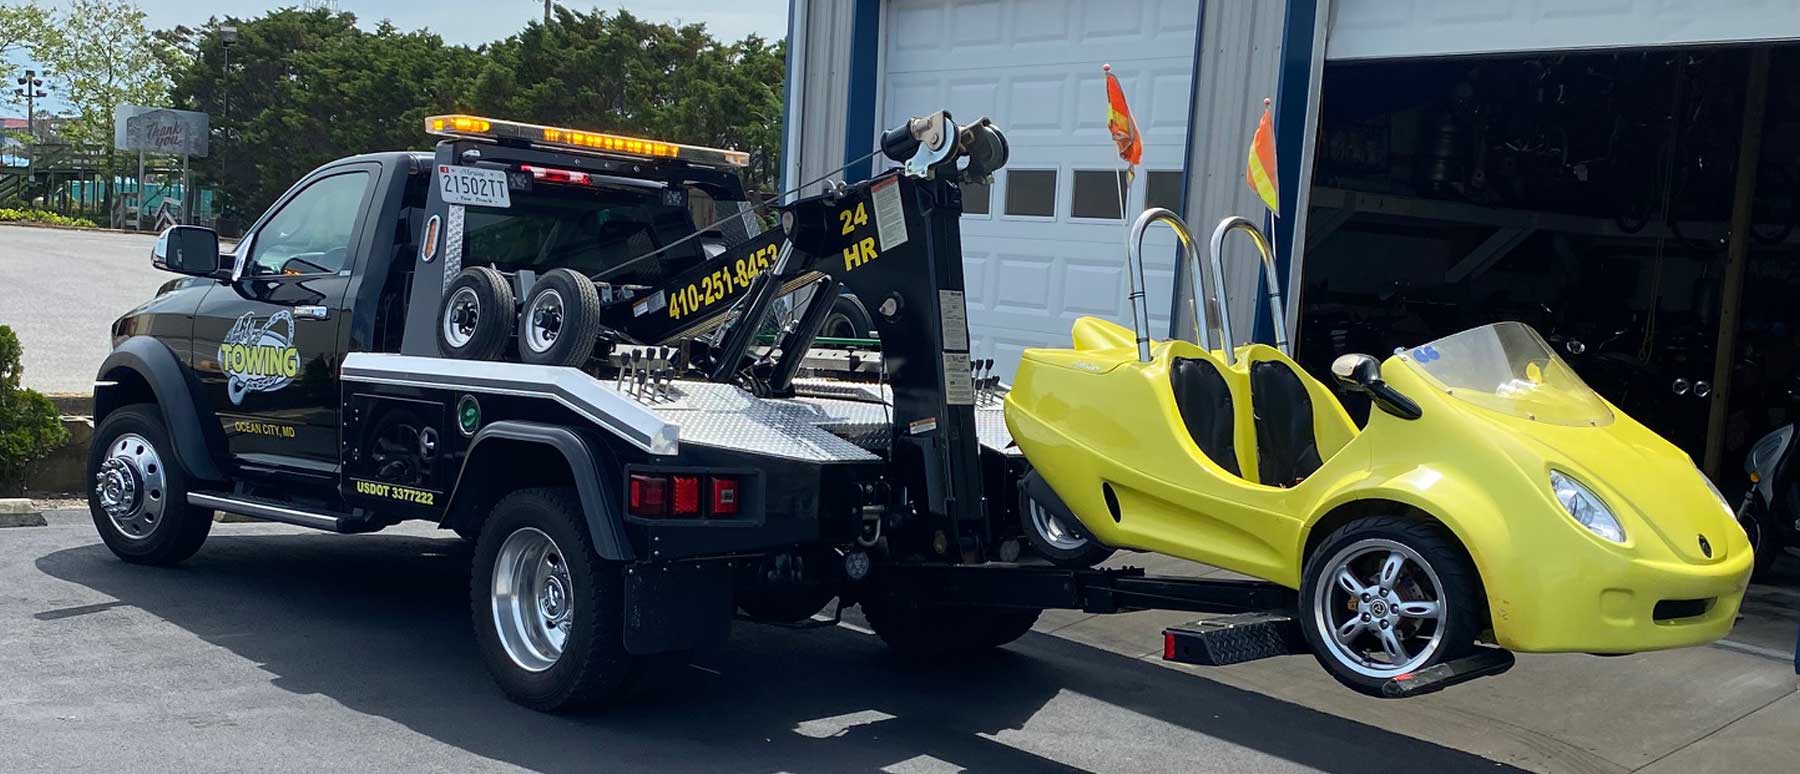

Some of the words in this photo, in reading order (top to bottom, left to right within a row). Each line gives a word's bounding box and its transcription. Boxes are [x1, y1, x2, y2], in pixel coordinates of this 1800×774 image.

[147, 120, 182, 139] Thank
[443, 174, 505, 198] 21502TT
[839, 201, 868, 235] 24
[843, 236, 878, 272] HR
[221, 343, 298, 378] TOWING
[234, 421, 262, 434] OCEAN
[262, 423, 282, 438] CITY,
[281, 425, 295, 438] MD
[356, 481, 390, 497] USDOT
[391, 487, 434, 505] 3377222
